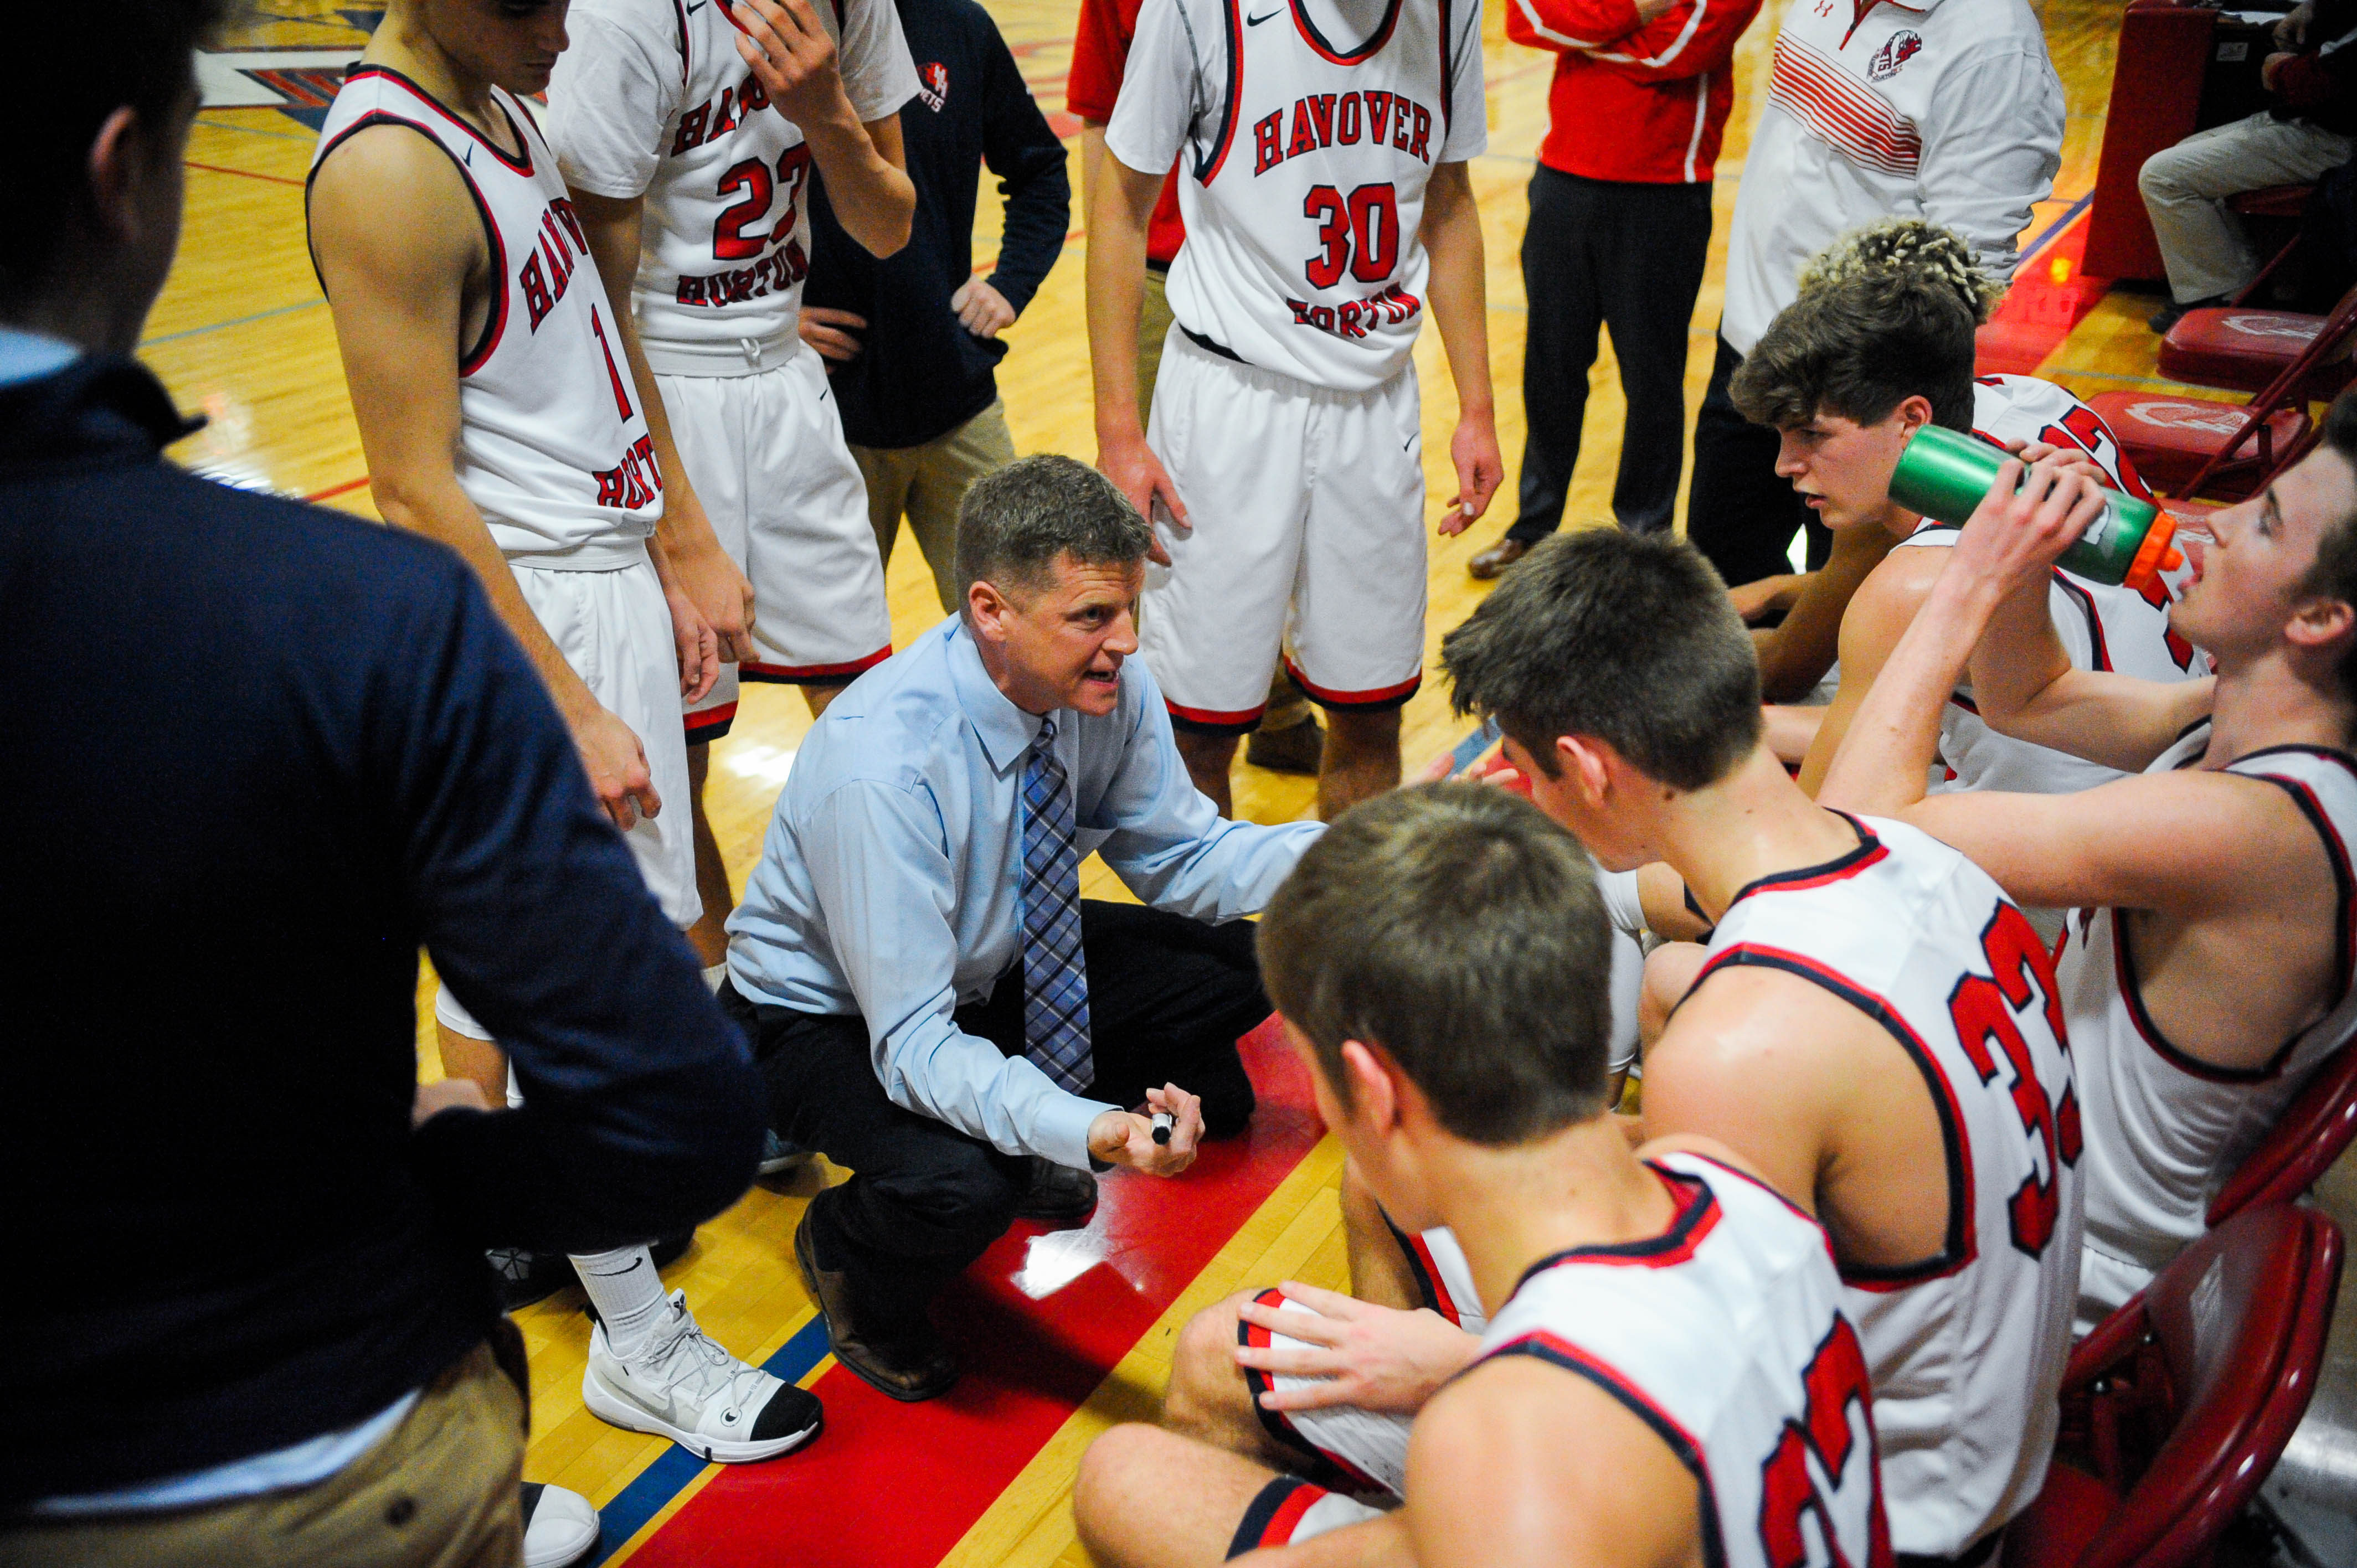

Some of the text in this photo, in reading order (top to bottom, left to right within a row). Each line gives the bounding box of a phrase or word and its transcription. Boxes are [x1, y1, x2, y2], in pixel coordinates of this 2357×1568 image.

[919, 87, 945, 112] ETS
[1253, 90, 1432, 178] HANOVER
[712, 140, 812, 261] 23
[1303, 181, 1400, 291] 30
[590, 302, 634, 425] 1
[1946, 896, 2084, 1262] 33
